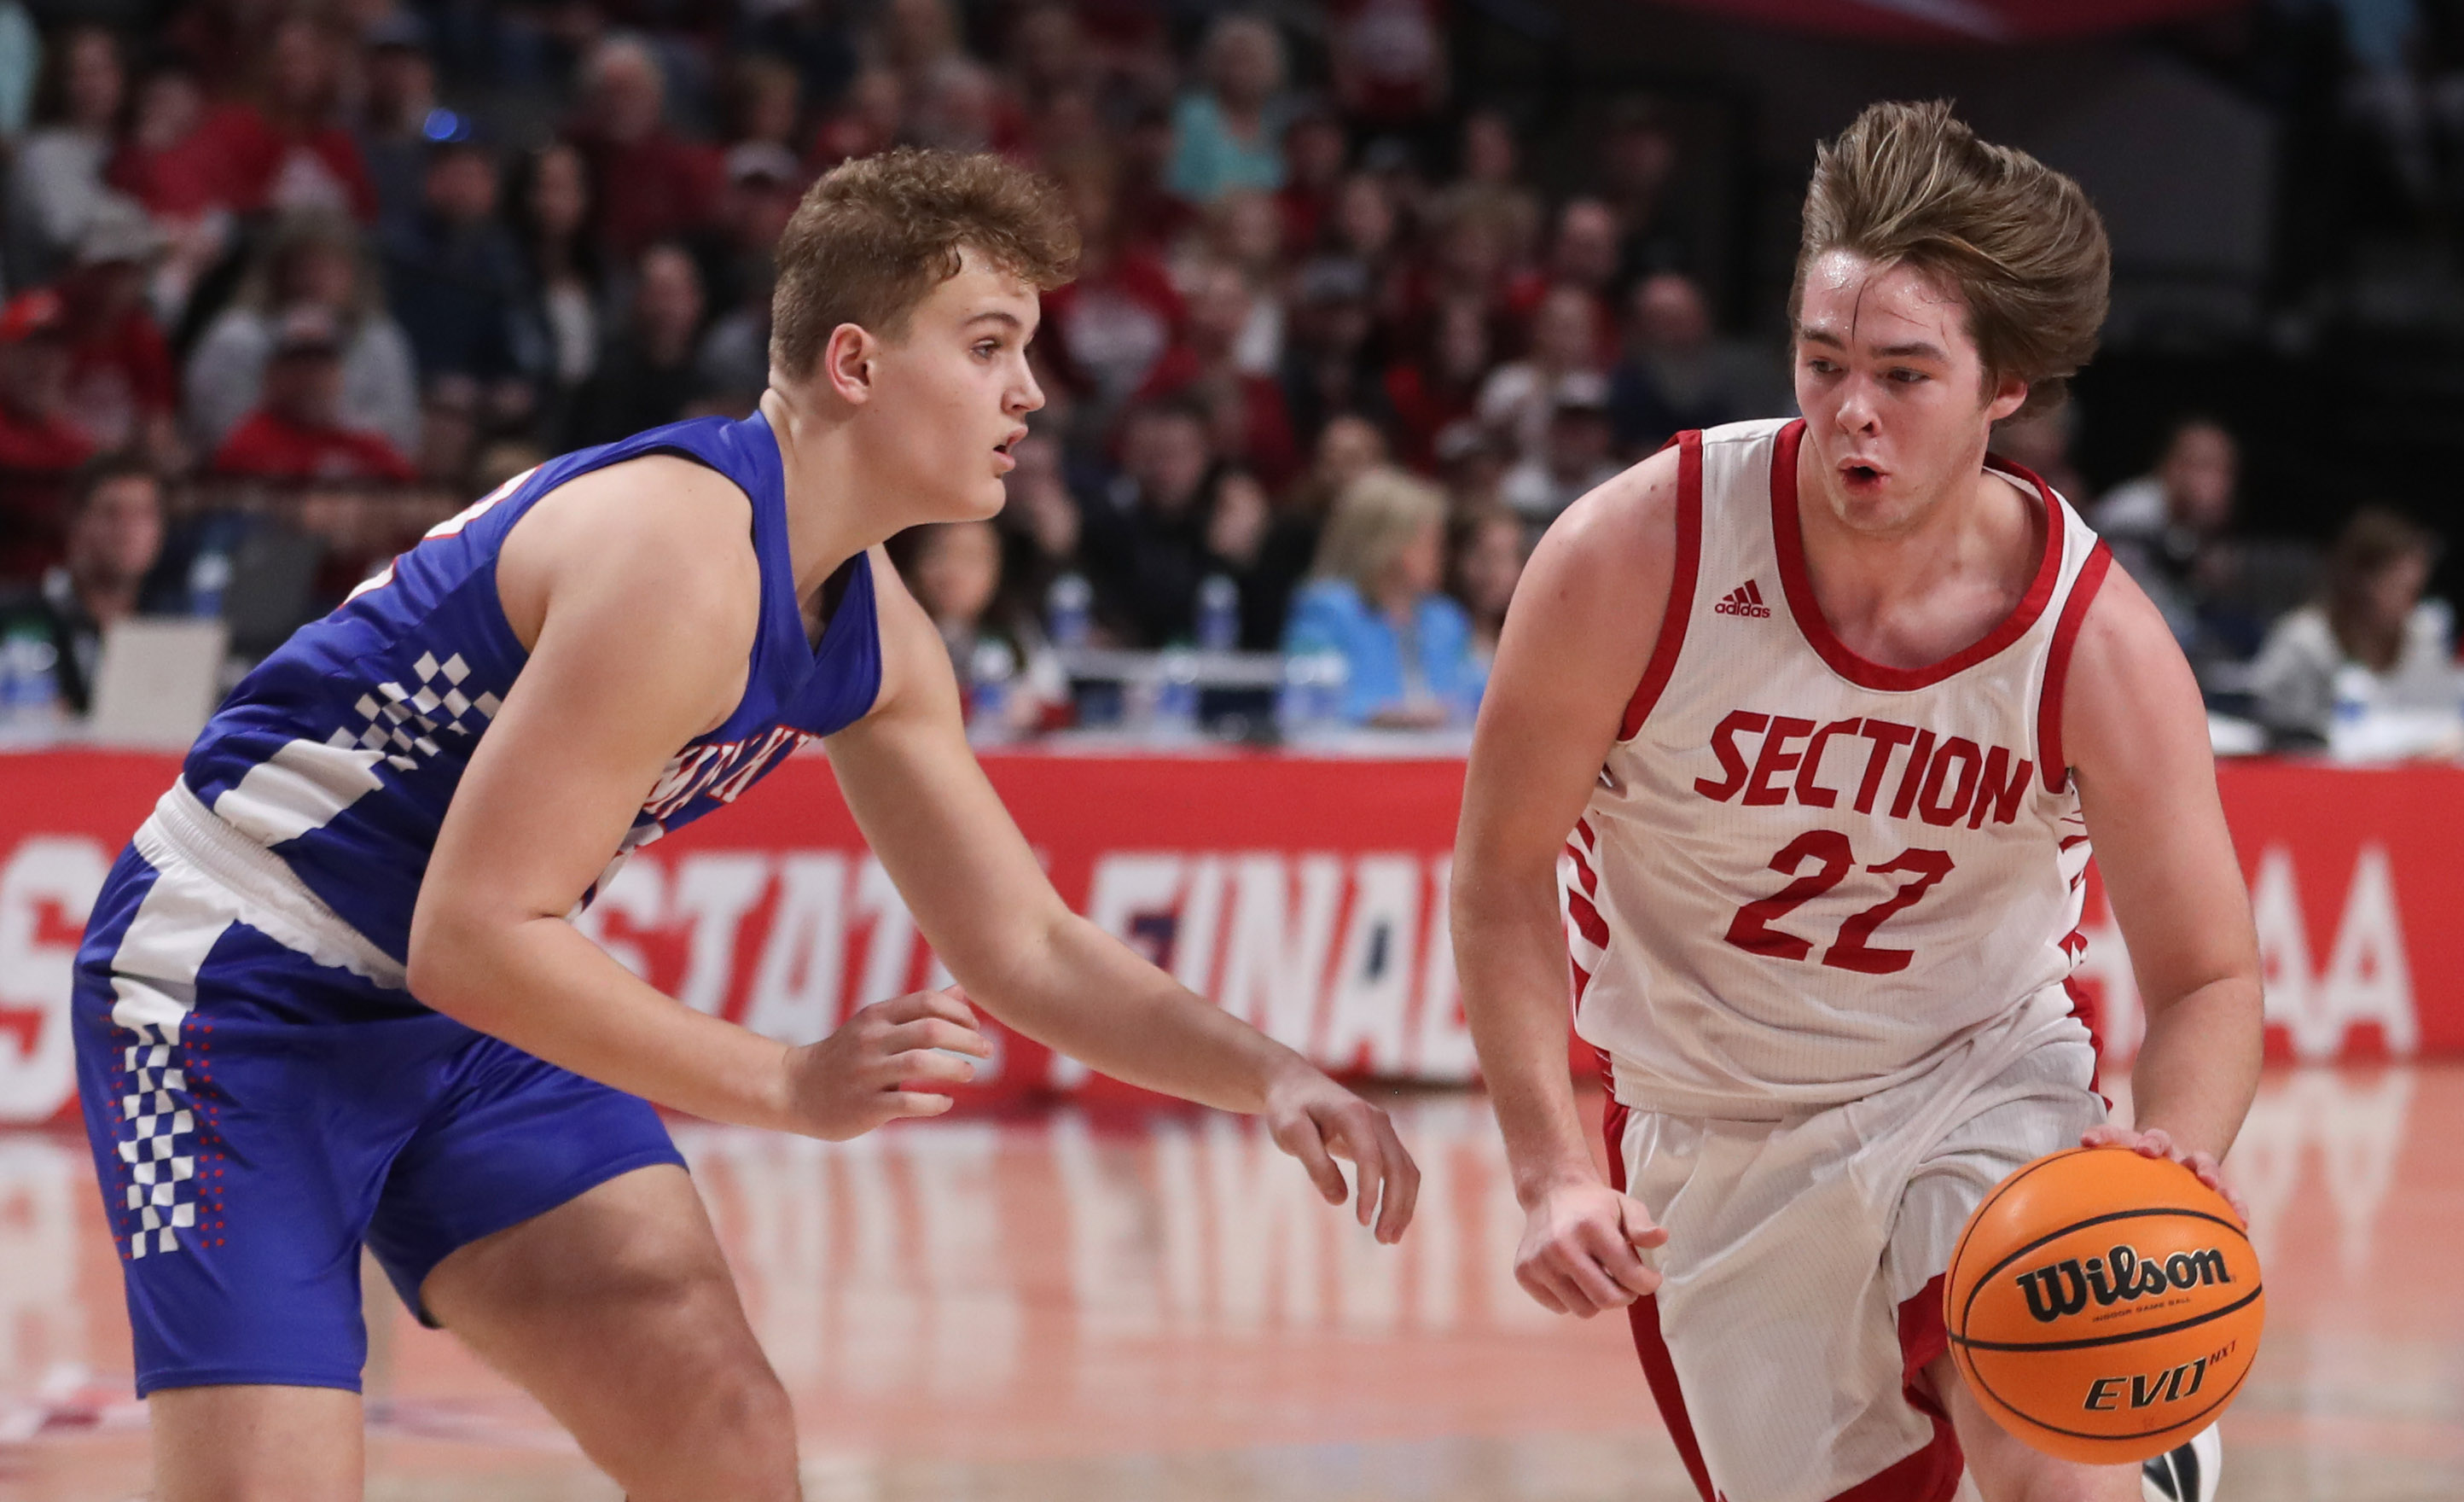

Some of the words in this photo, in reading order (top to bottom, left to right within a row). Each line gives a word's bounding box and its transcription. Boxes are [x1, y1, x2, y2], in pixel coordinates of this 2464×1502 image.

[1714, 601, 1771, 619] adidas
[1694, 709, 2034, 830] SECTION
[1723, 830, 1956, 975] 22
[567, 849, 1049, 1086] STAT
[2015, 1244, 2232, 1324] Wilson
[2092, 1308, 2132, 1323] INDOOR
[2136, 1301, 2165, 1313] GAME
[2168, 1296, 2191, 1307] BALL
[2082, 1356, 2208, 1412] EVO
[2209, 1338, 2237, 1366] NXT
